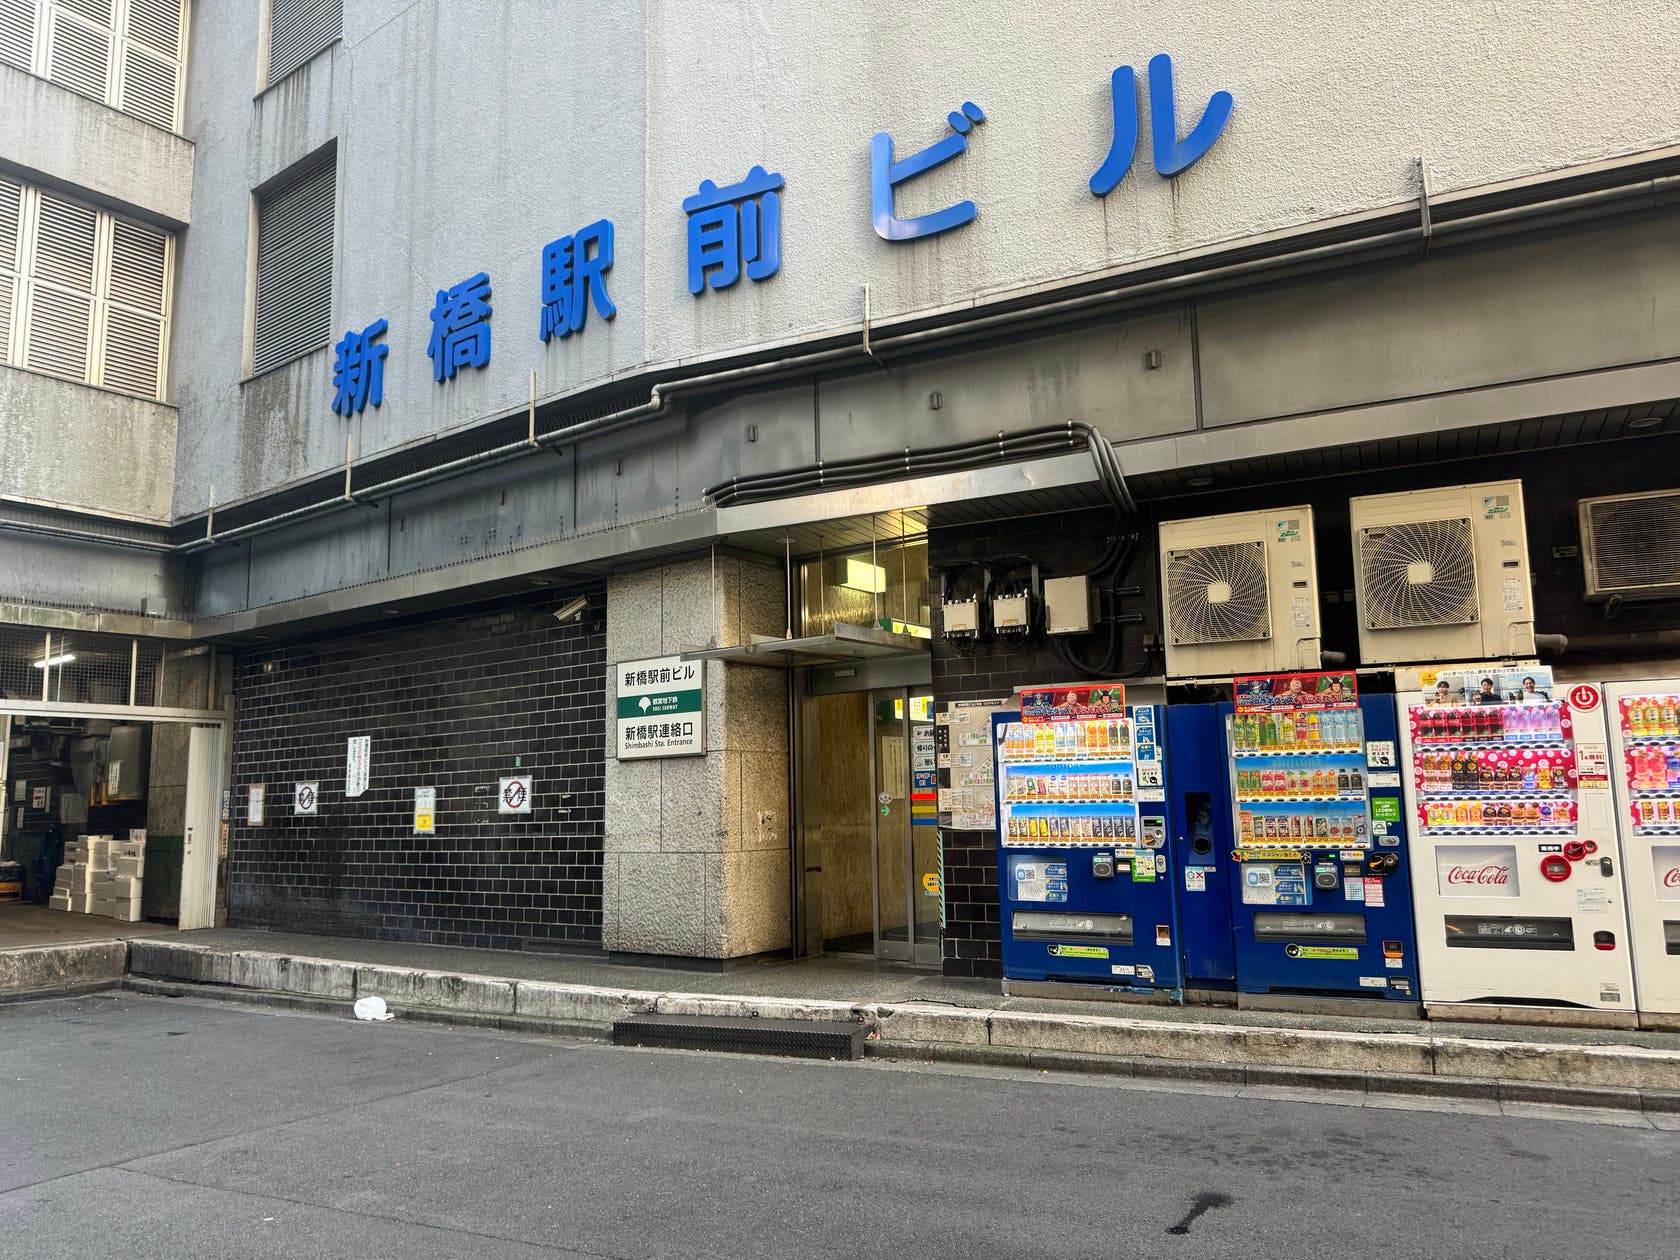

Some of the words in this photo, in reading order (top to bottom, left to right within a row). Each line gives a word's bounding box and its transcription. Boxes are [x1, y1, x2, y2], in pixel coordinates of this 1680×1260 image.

[331, 53, 1235, 416] 新橋駅前ビル
[625, 665, 695, 687] 新橋駅前ビル
[625, 722, 693, 741] 新橋駅連絡口
[625, 741, 654, 750] Shimbashi
[655, 740, 666, 748] Sta.
[1448, 865, 1512, 885] Coca-Cola
